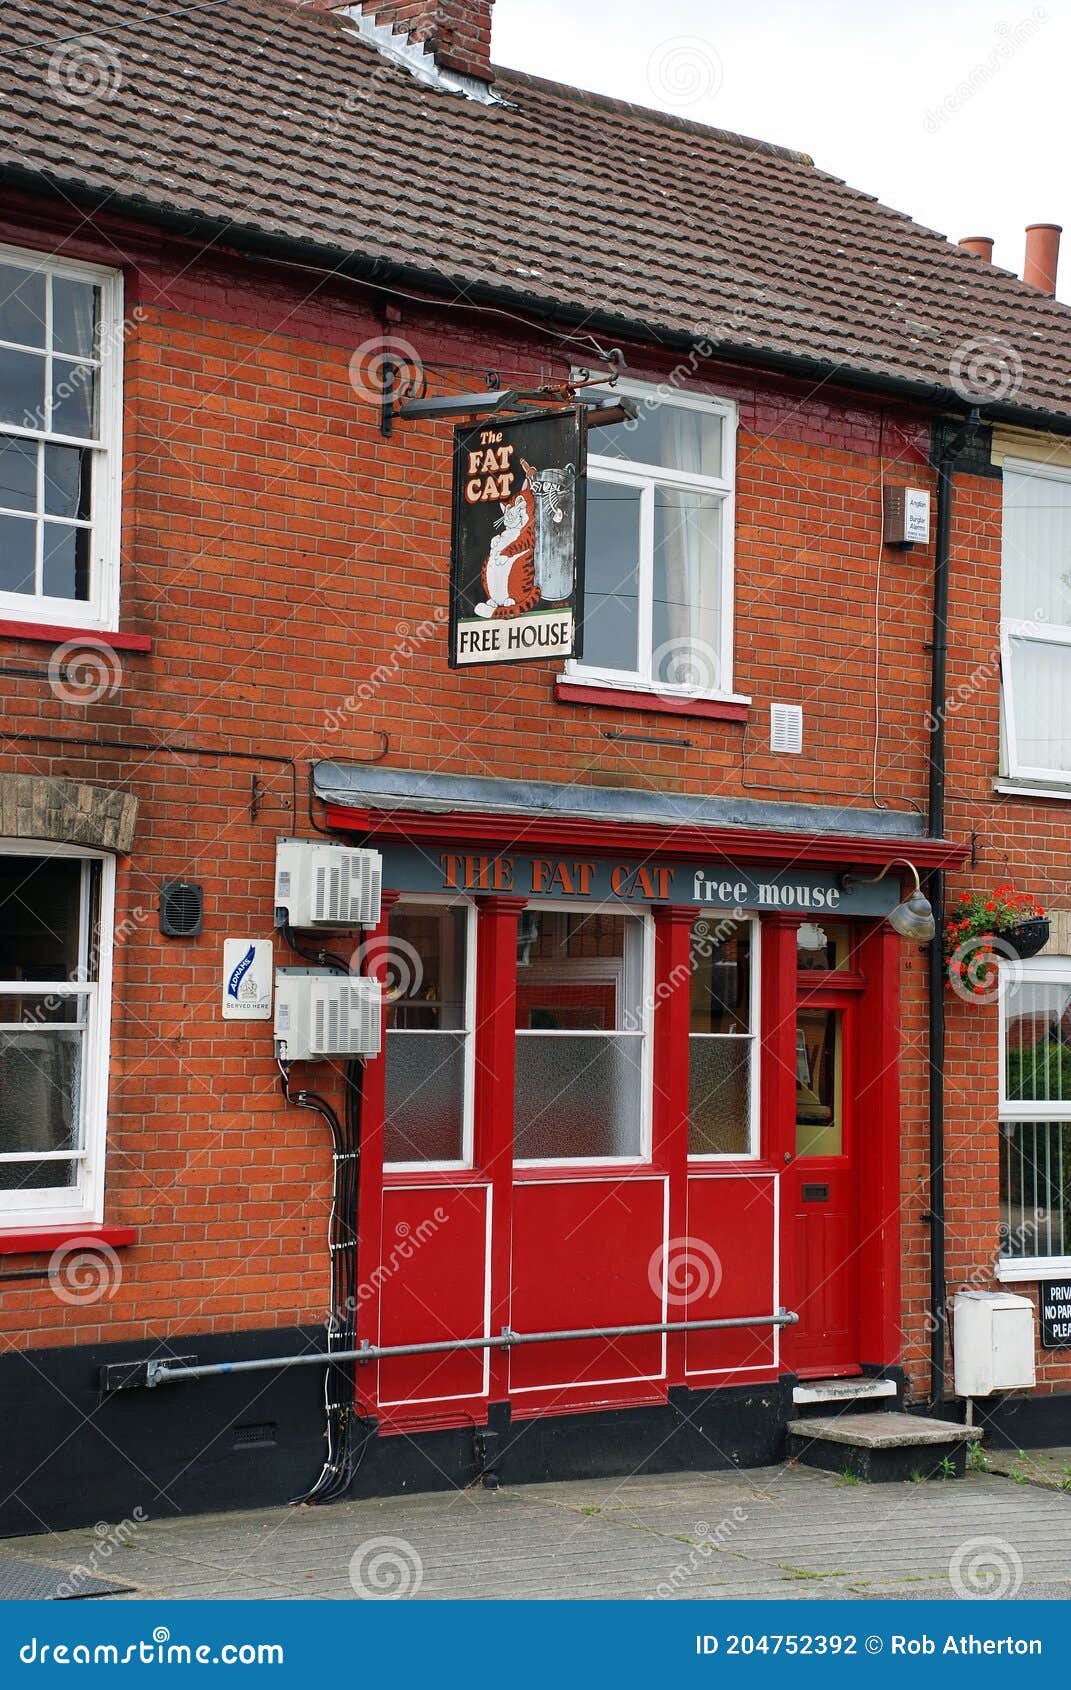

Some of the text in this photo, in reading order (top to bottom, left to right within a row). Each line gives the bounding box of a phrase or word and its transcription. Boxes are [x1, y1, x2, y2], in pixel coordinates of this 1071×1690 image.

[480, 430, 503, 445] The
[468, 444, 514, 474] FAT
[465, 472, 515, 504] CAT
[460, 622, 569, 653] FREE HOUSE
[440, 854, 841, 908] THE FAT CAT free mouse
[230, 958, 252, 992] ADNAMS
[1044, 1305, 1057, 1320] NO
